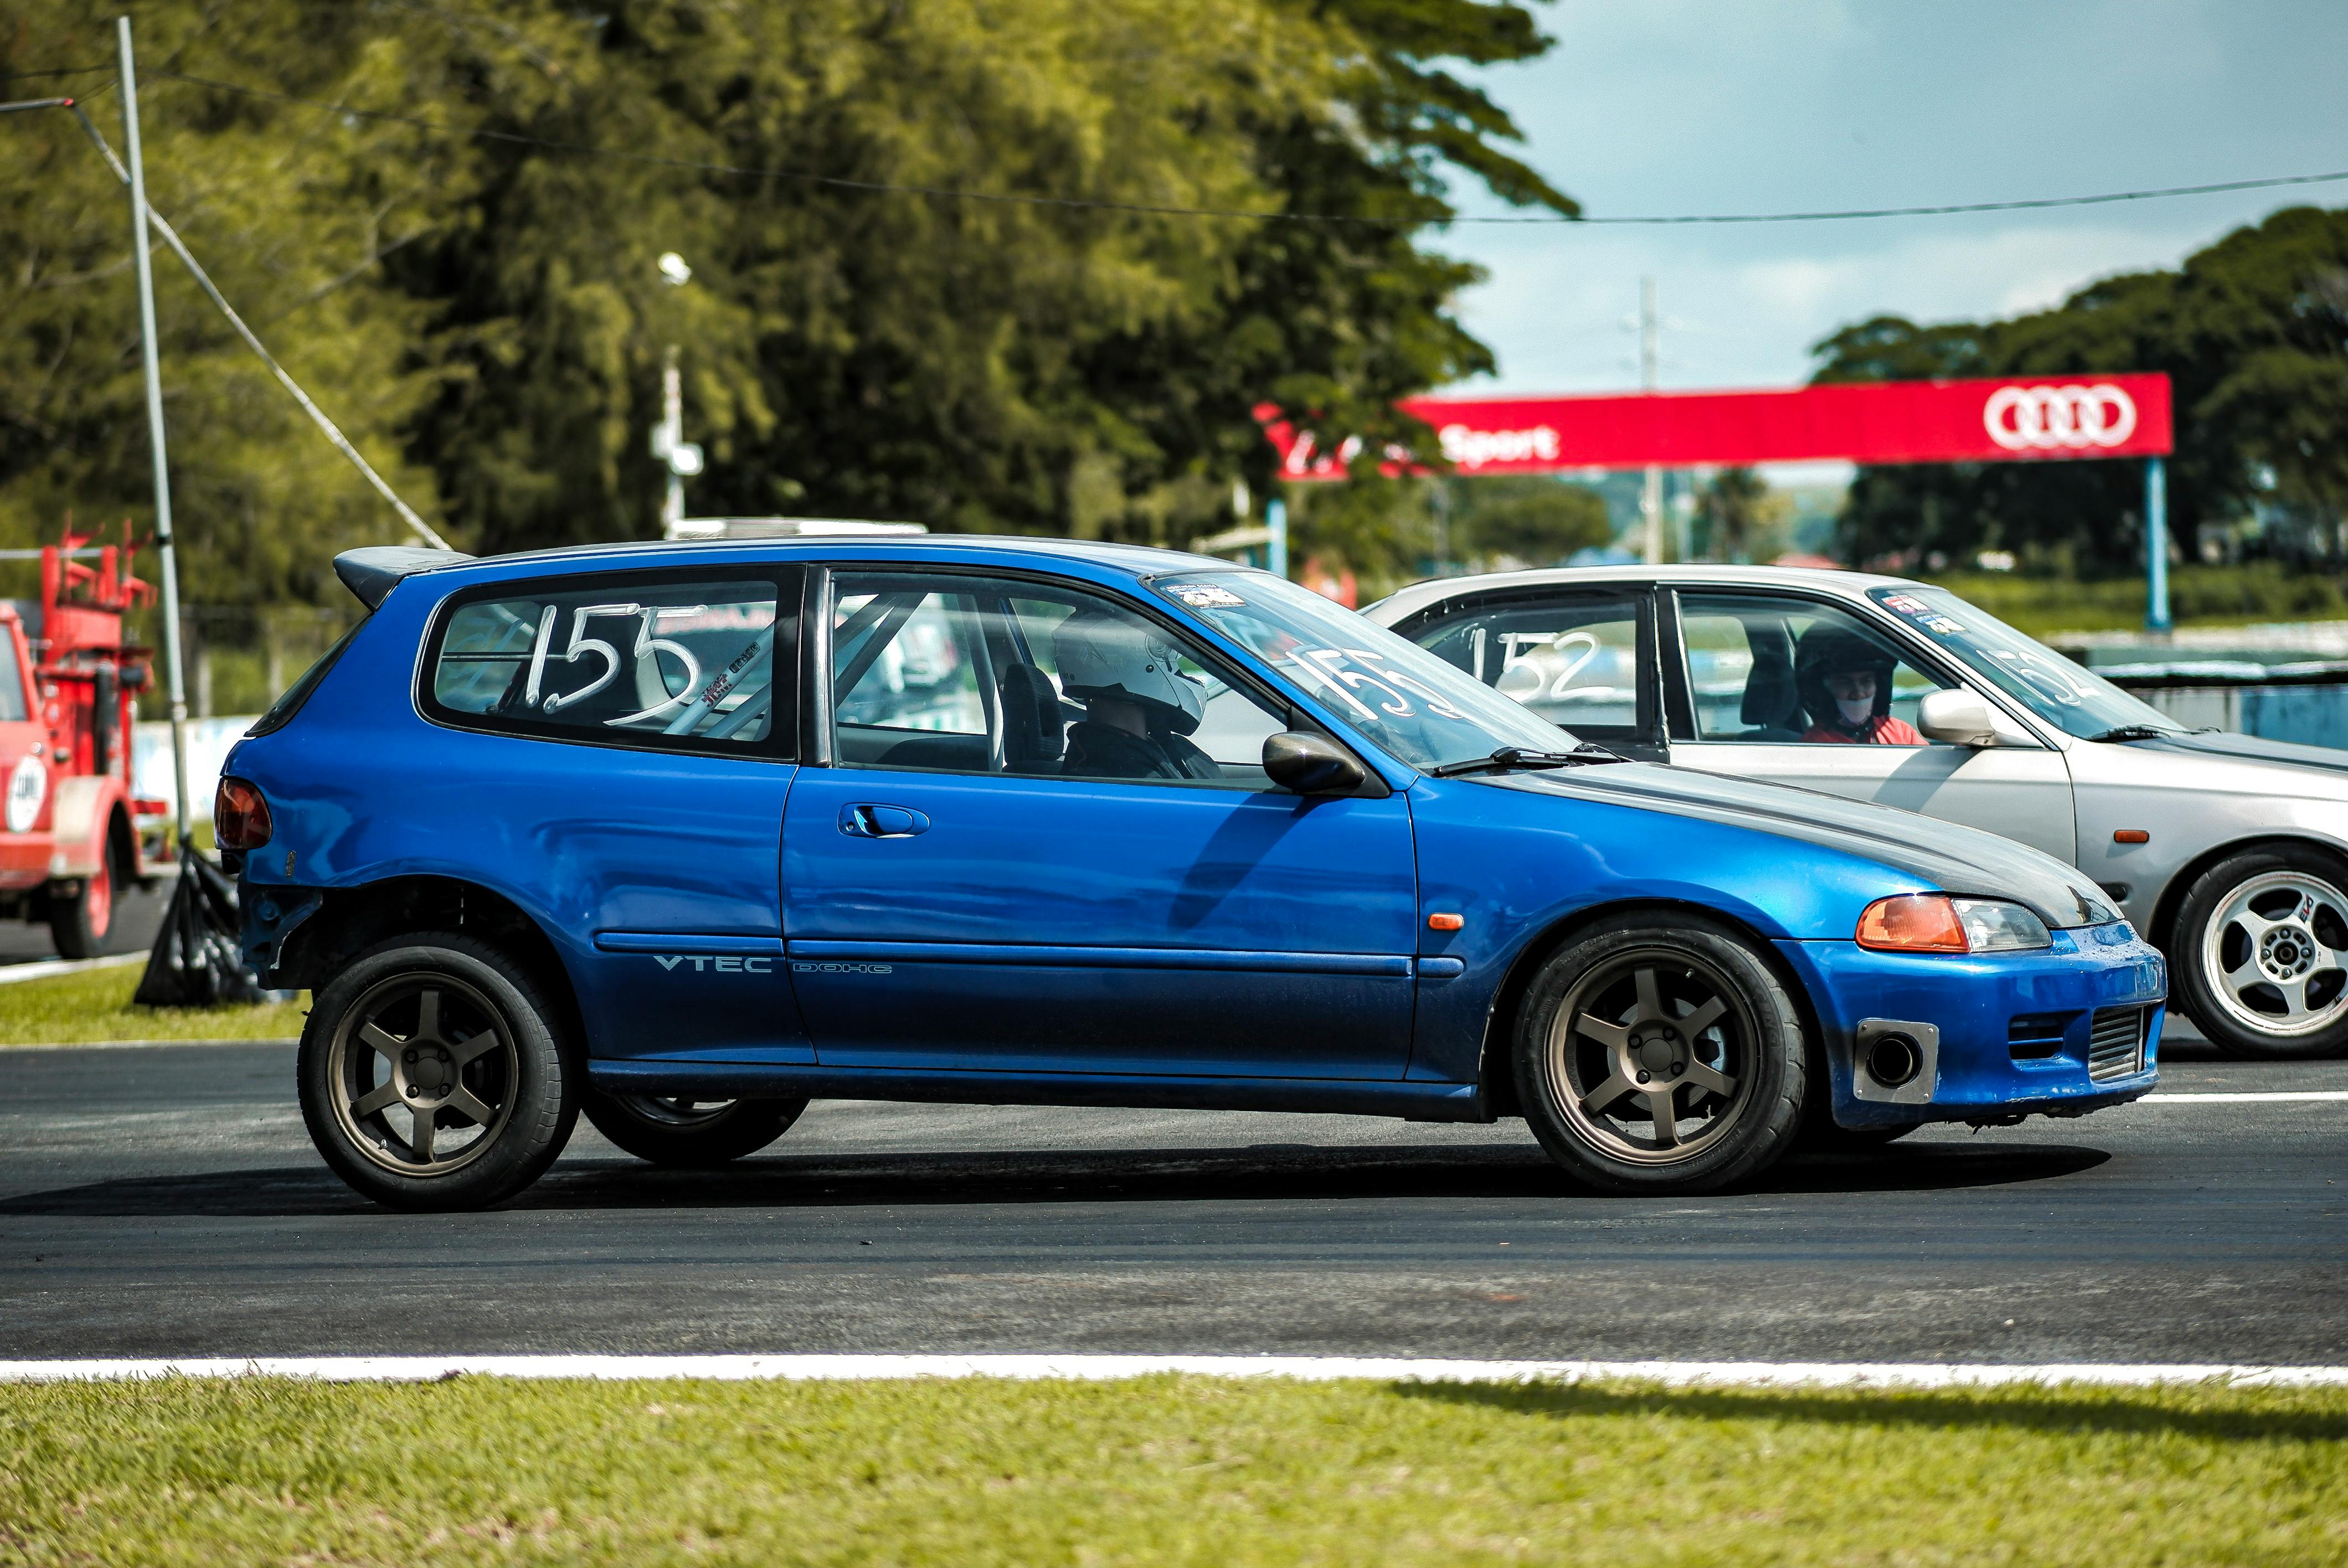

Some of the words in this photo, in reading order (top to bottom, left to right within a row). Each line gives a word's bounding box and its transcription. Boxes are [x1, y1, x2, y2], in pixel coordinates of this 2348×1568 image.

[1439, 423, 1561, 470] Sport
[526, 602, 709, 726] 155
[1285, 648, 1463, 720] 155
[1472, 627, 1616, 703] 152
[653, 956, 772, 973] VTEC
[794, 963, 892, 973] DOHC
